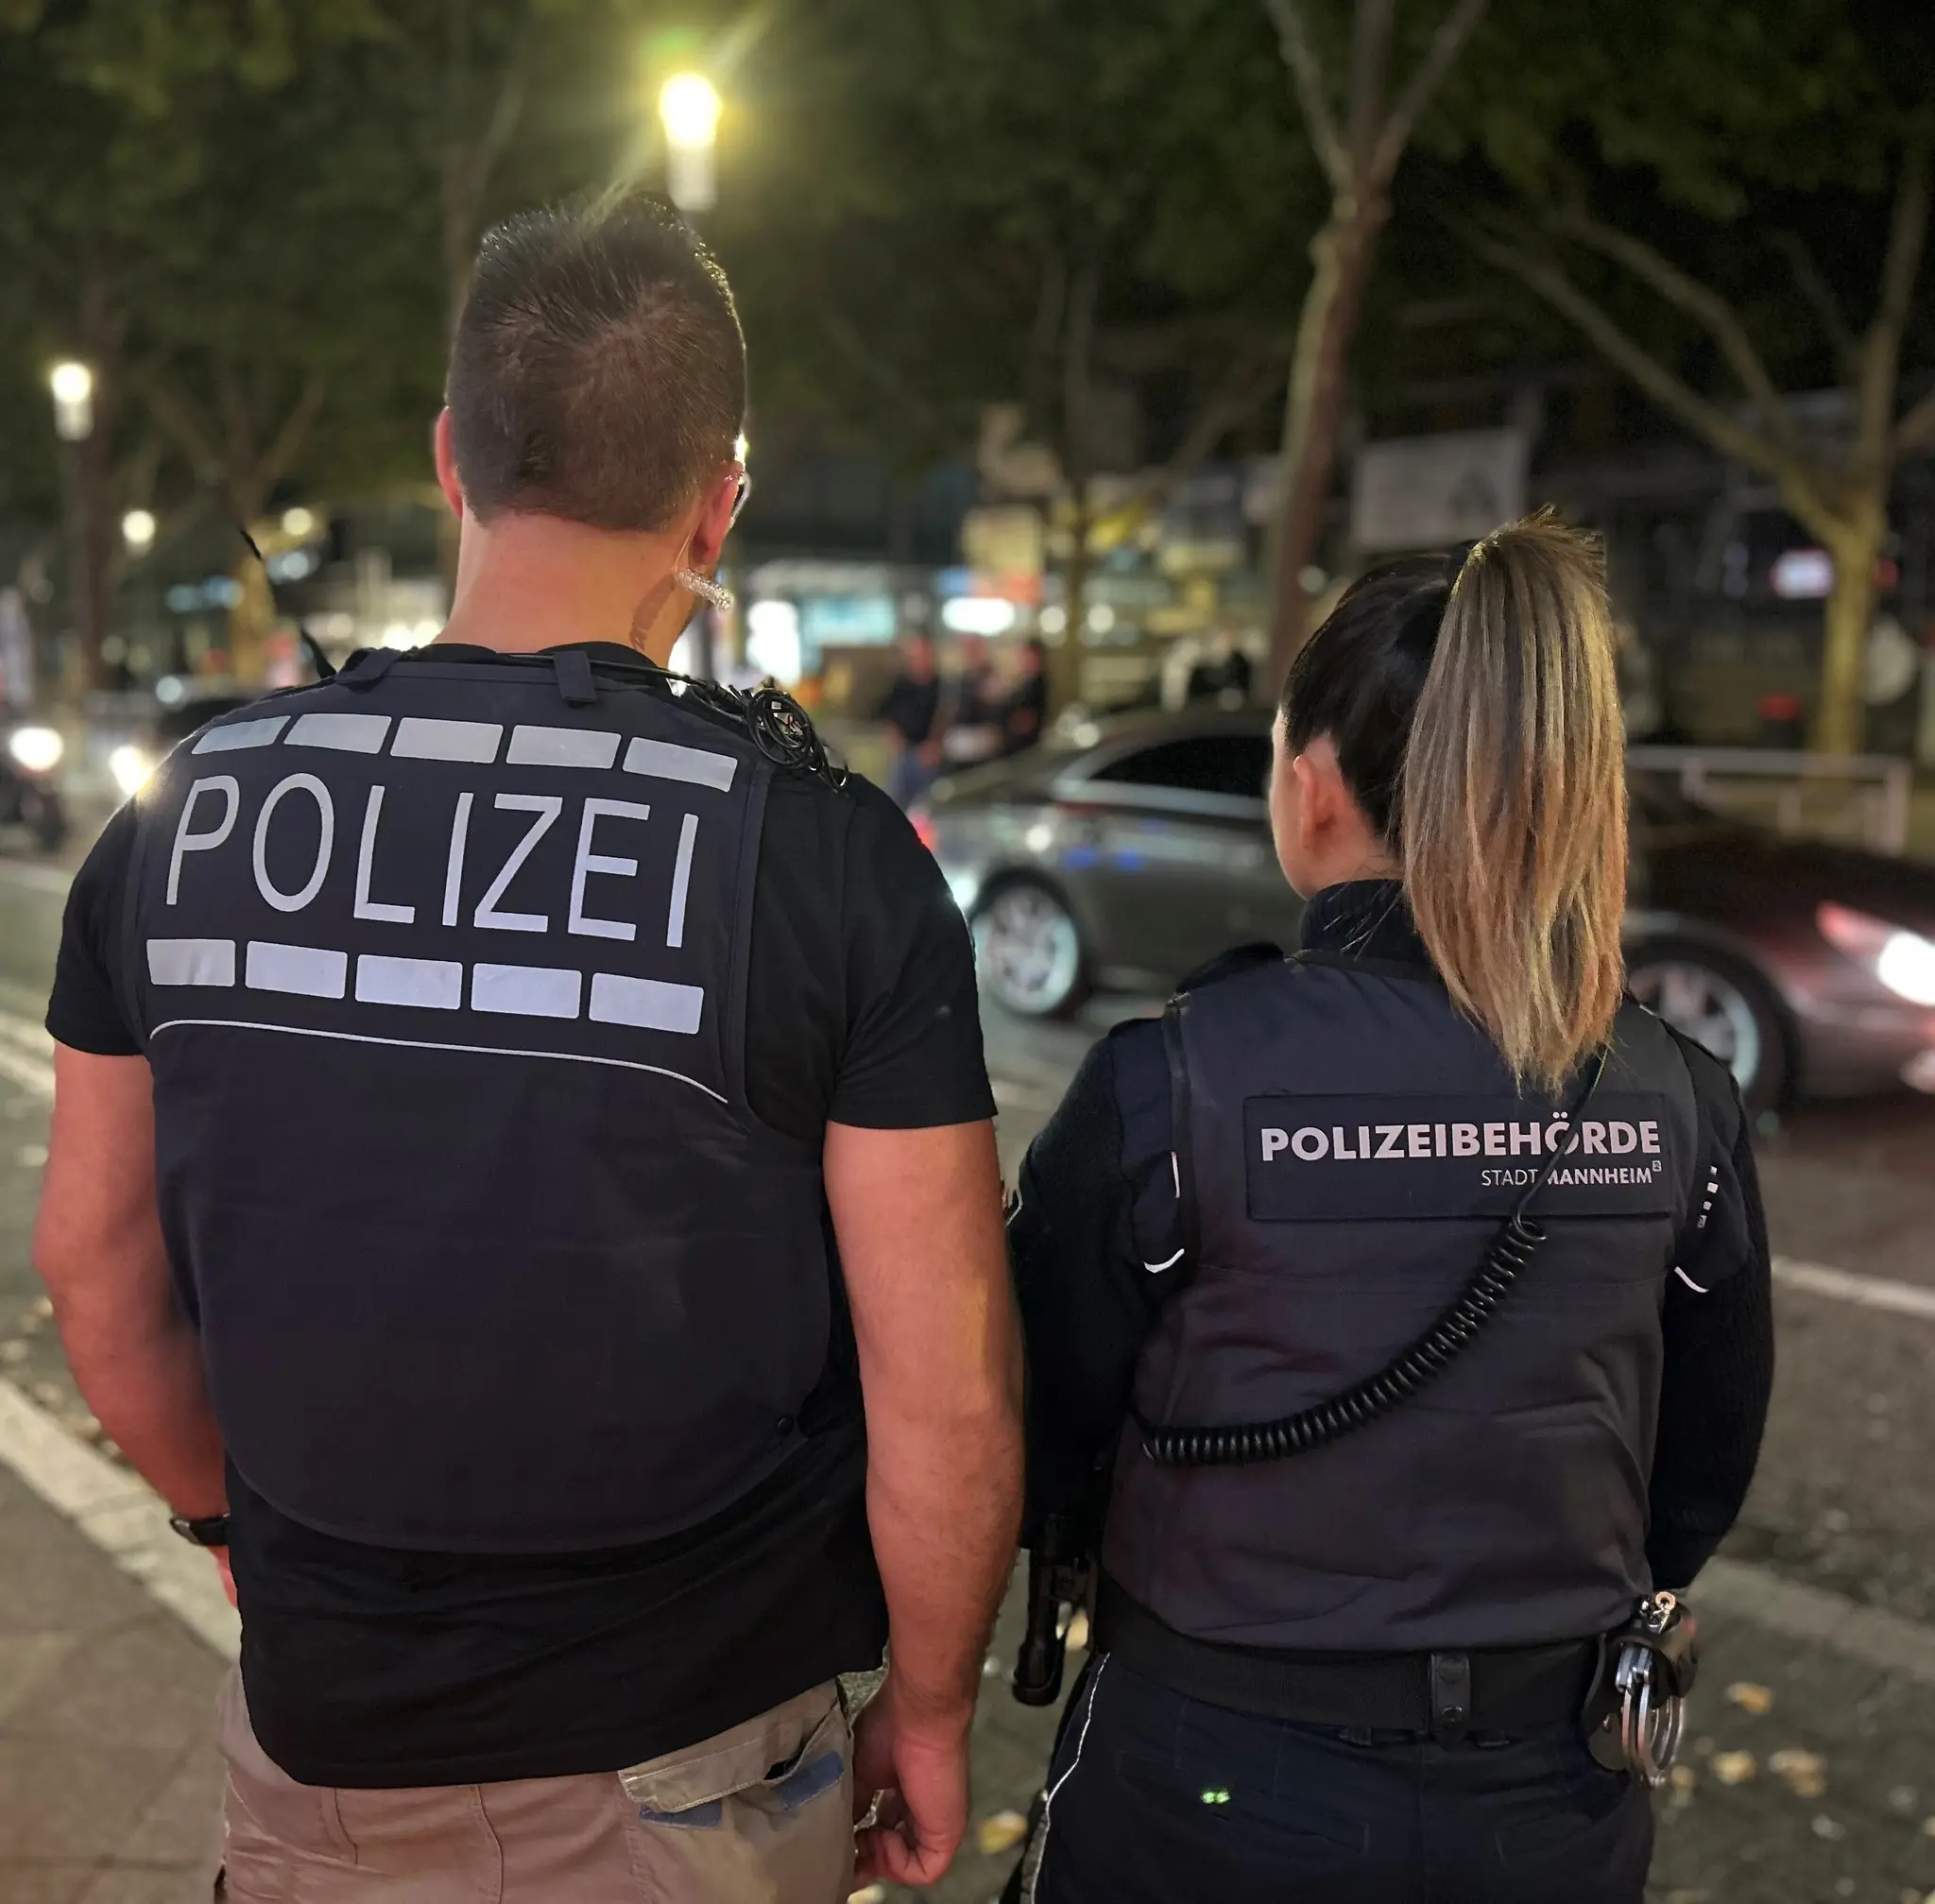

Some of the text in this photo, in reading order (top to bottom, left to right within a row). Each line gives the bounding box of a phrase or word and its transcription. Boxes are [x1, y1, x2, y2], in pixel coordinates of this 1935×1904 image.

[166, 773, 699, 948] POLIZEI
[1260, 1111, 1661, 1161] POLIZEIBEHÖRDE
[1481, 1169, 1539, 1186] STADT
